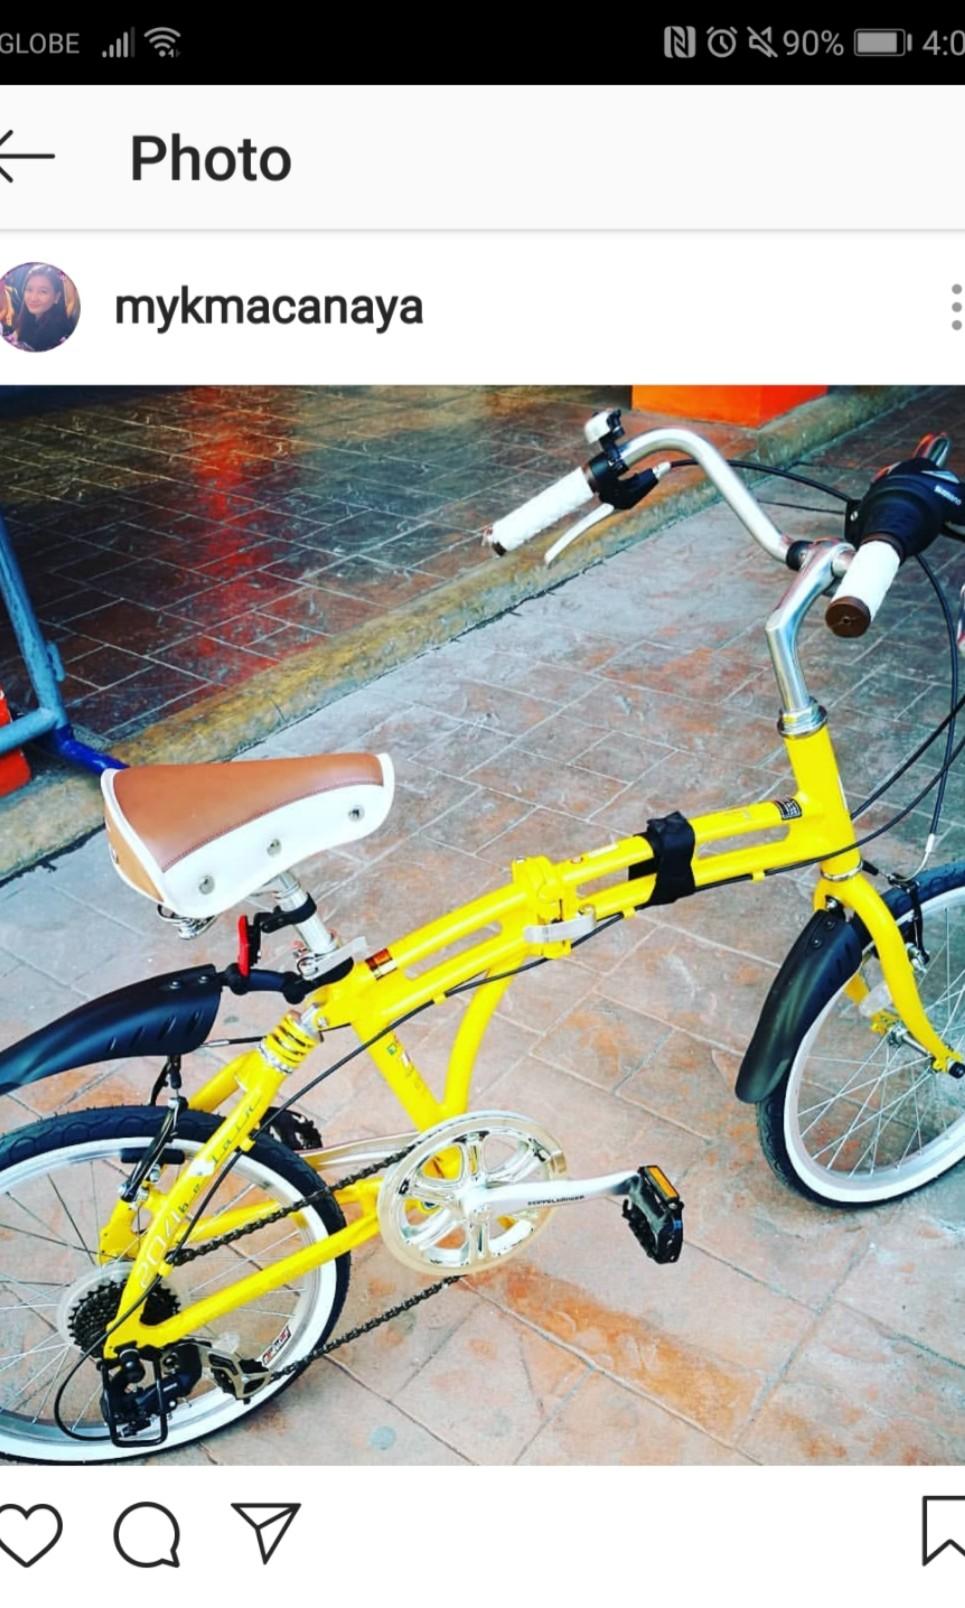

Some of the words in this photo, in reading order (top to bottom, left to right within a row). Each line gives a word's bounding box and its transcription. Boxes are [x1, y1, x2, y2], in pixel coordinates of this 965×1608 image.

[0, 32, 80, 55] GLOBE
[782, 29, 845, 56] 90%
[132, 132, 292, 182] Photo
[116, 285, 424, 335] mykmacanaya
